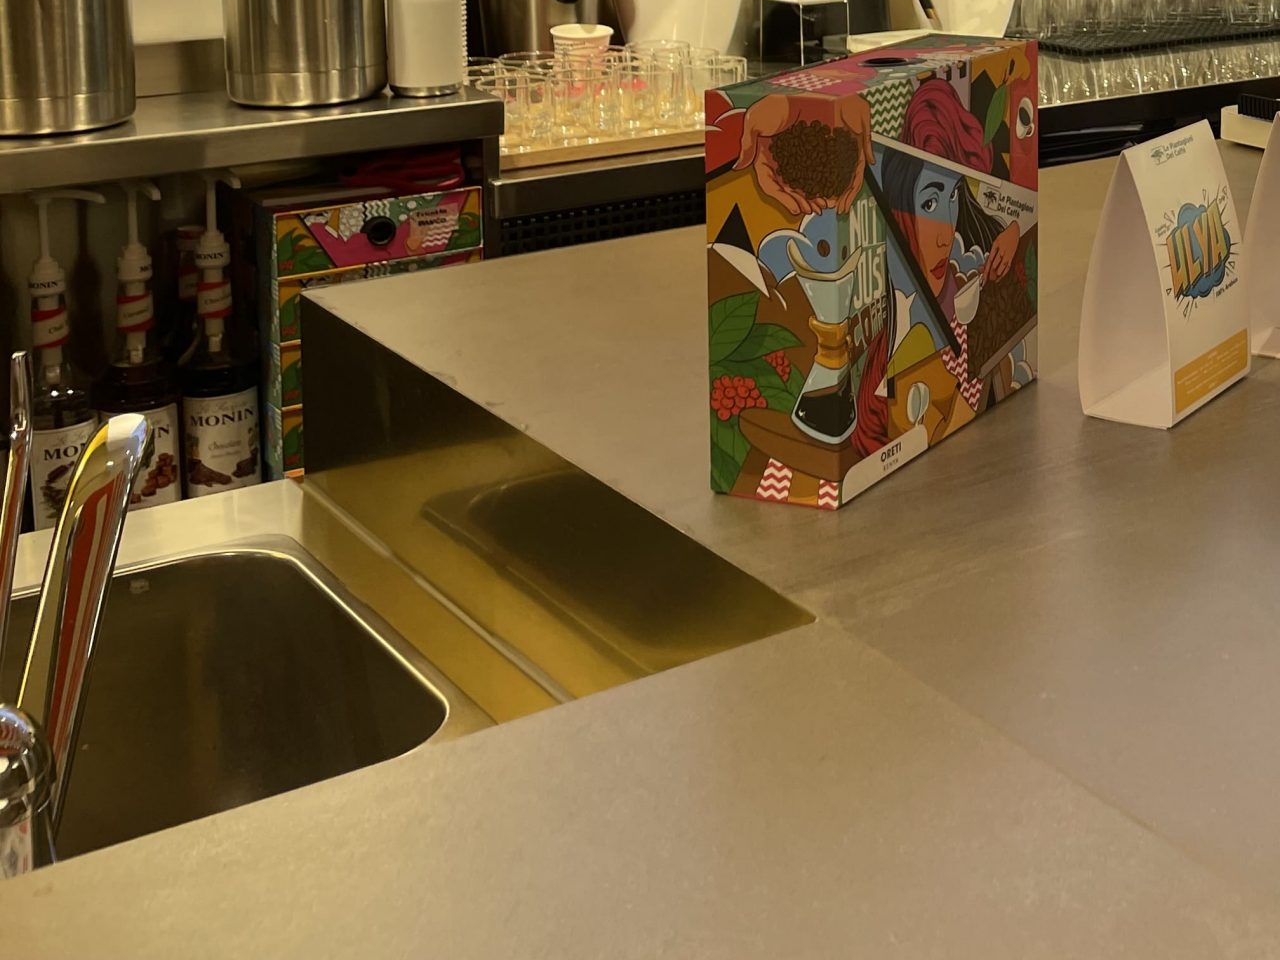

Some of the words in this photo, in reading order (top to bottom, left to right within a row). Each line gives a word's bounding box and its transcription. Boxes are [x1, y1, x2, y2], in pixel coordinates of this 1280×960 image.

[854, 245, 887, 310] JUST
[190, 407, 254, 427] MONIN
[881, 441, 901, 462] ORETI
